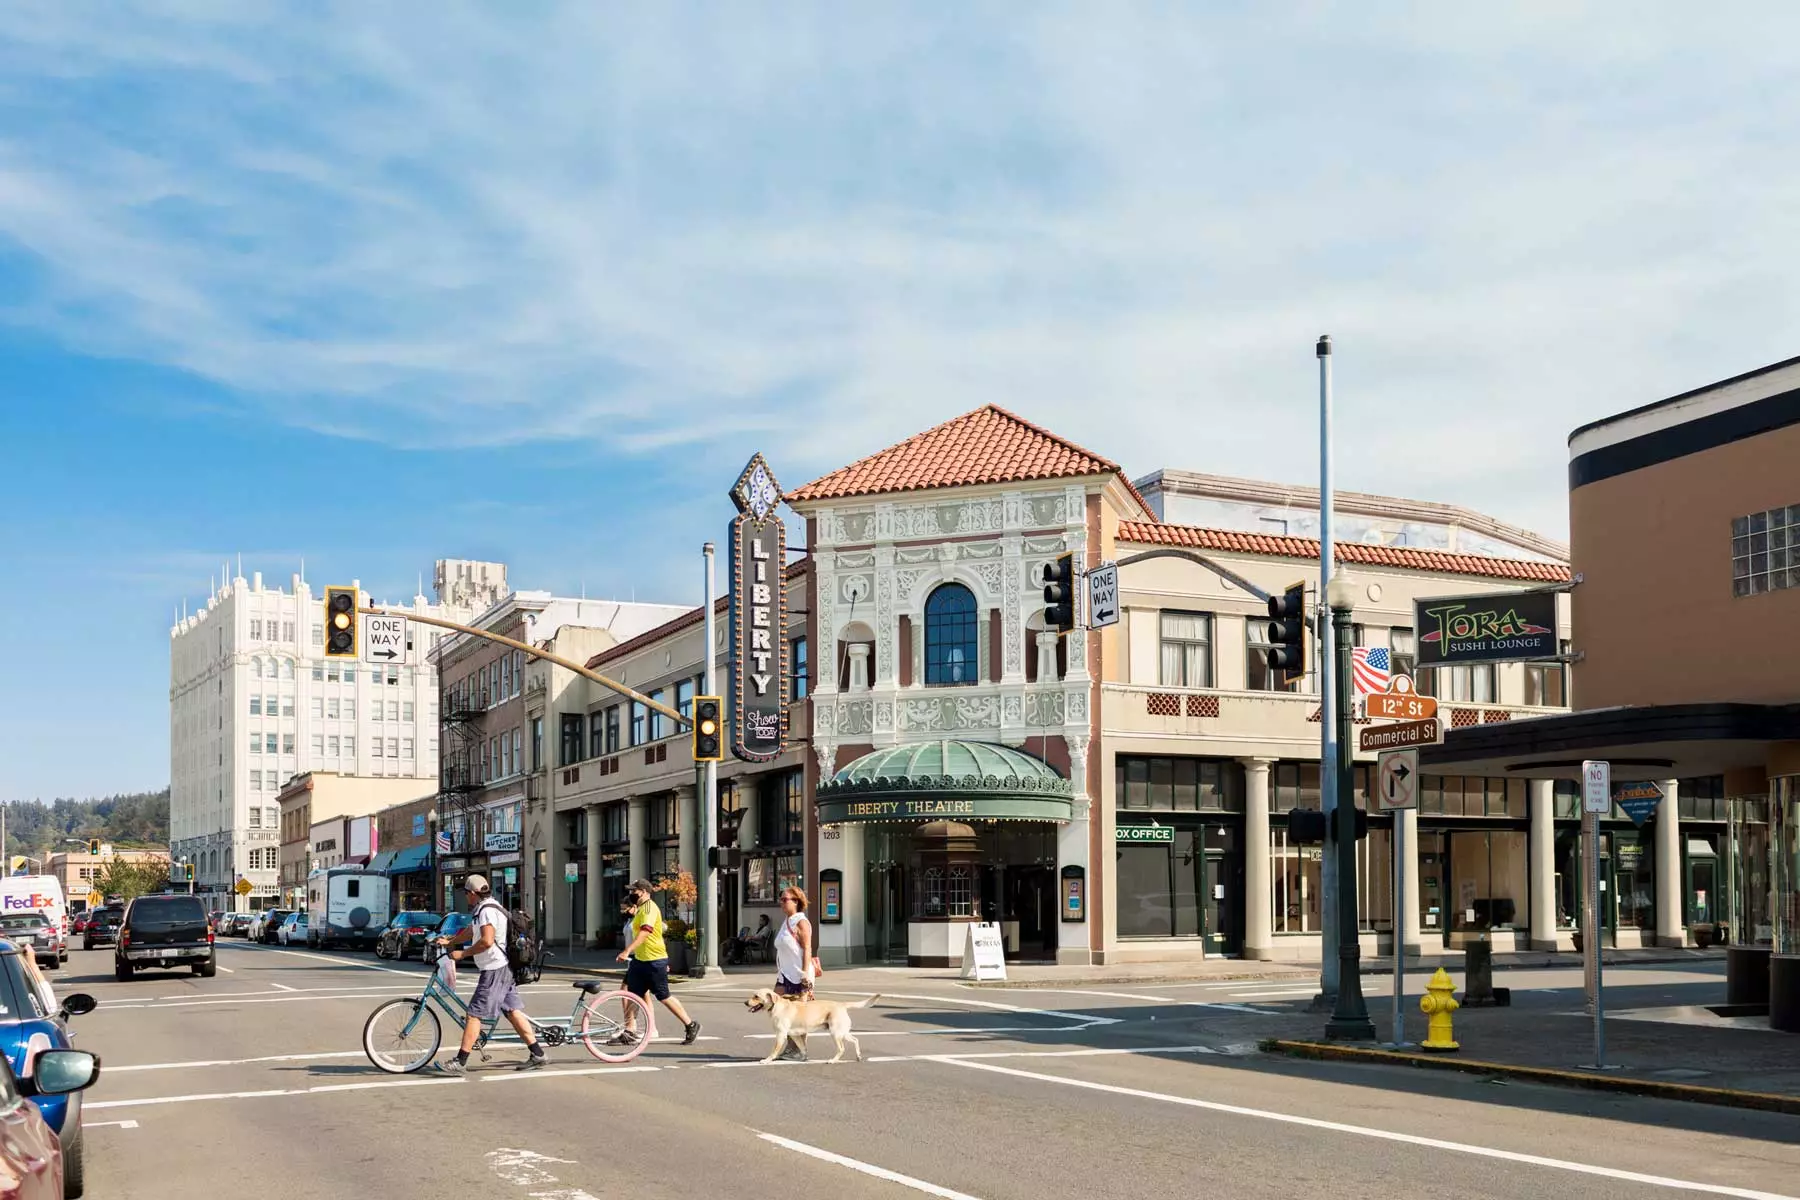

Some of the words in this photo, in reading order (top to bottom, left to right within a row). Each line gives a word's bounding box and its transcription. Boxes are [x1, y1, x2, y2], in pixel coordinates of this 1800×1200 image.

[1093, 572, 1113, 589] ONE
[1093, 588, 1114, 606] WAY
[751, 538, 773, 694] LIBERTY
[371, 620, 400, 631] ONE
[1425, 604, 1527, 656] TORA
[370, 633, 401, 645] WAY
[1450, 641, 1486, 652] SUSHI
[1491, 638, 1541, 650] LOUNGE
[1408, 700, 1423, 716] St
[746, 709, 779, 731] Show
[755, 729, 778, 737] TODAY
[1362, 726, 1419, 746] Commercial
[1423, 723, 1435, 739] St
[1590, 770, 1603, 781] NO
[847, 802, 900, 816] LIBERTY
[905, 800, 974, 813] THEATRE
[486, 835, 516, 848] BUTCHER
[823, 831, 841, 840] 1203
[1131, 829, 1170, 839] OFFICE
[4, 893, 55, 909] FedEx
